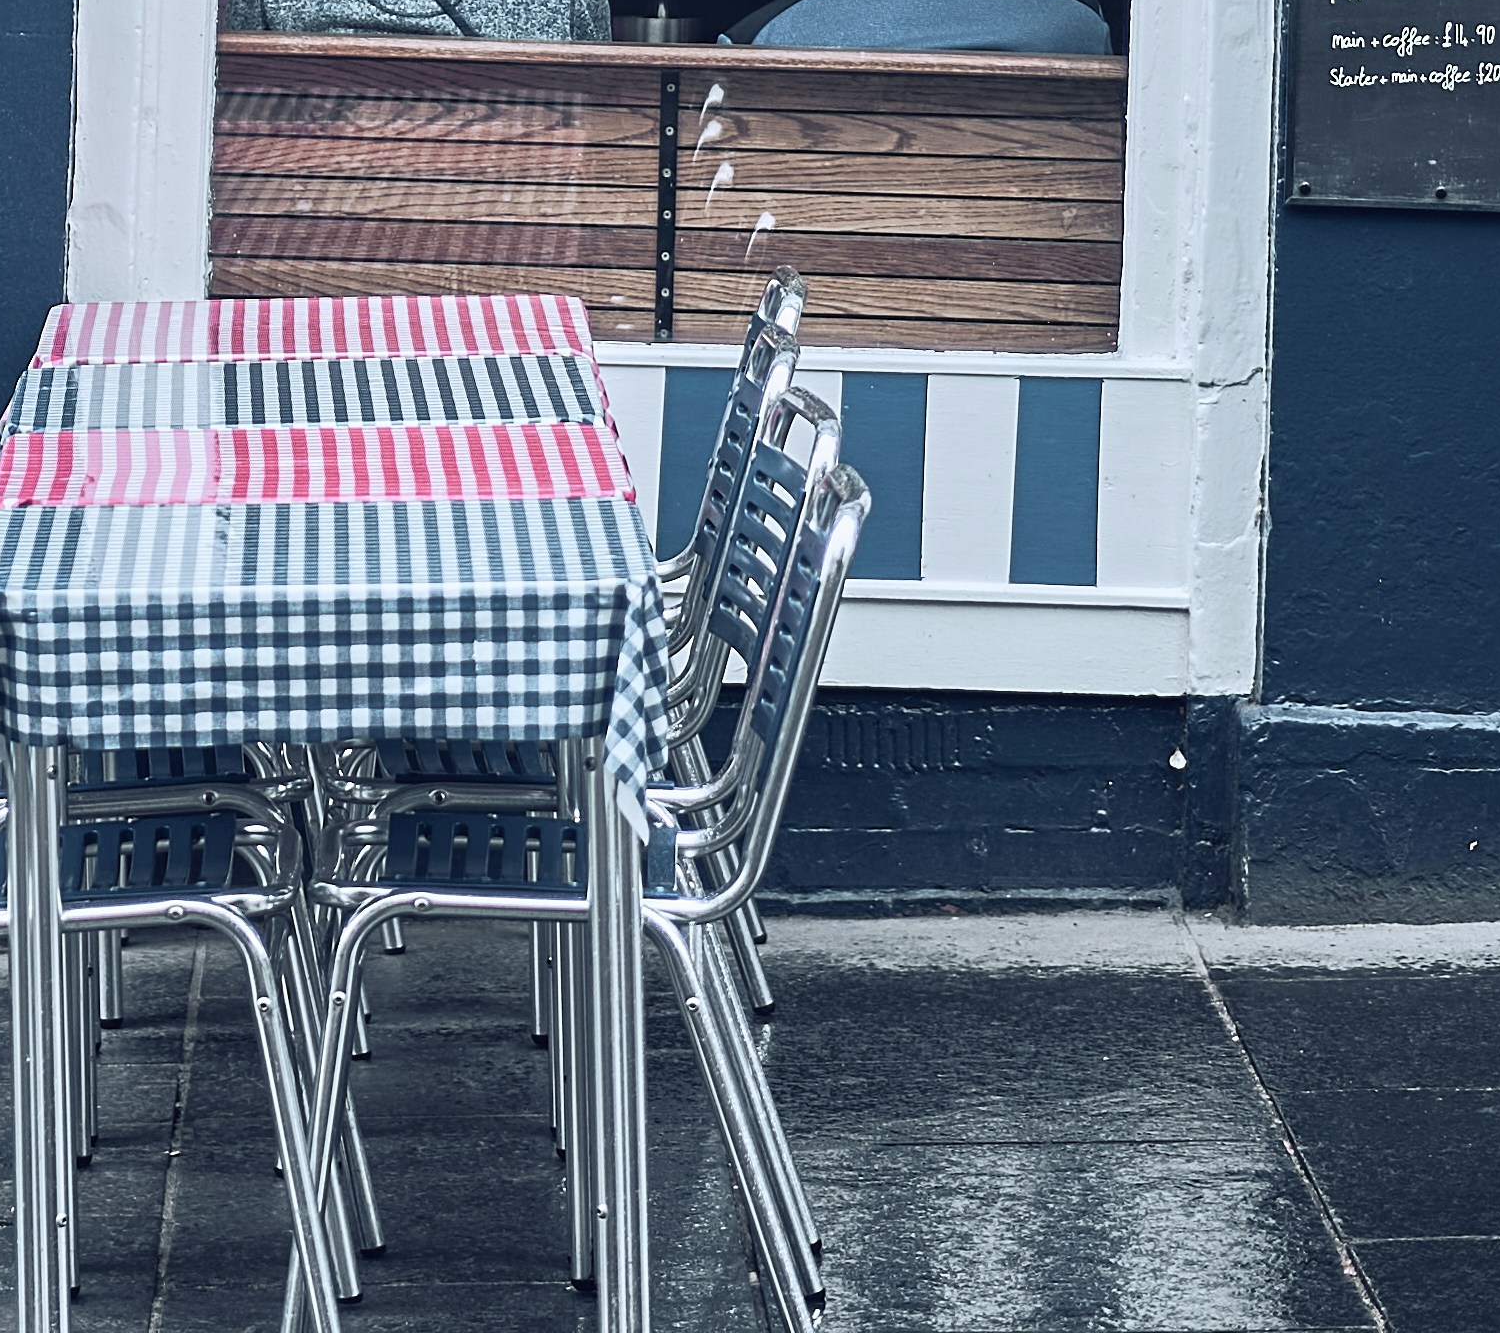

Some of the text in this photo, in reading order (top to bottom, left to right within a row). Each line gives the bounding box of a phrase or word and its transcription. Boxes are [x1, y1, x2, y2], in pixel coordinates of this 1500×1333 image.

[1331, 26, 1430, 57] main coffee
[1330, 63, 1471, 91] Starter main coffee
